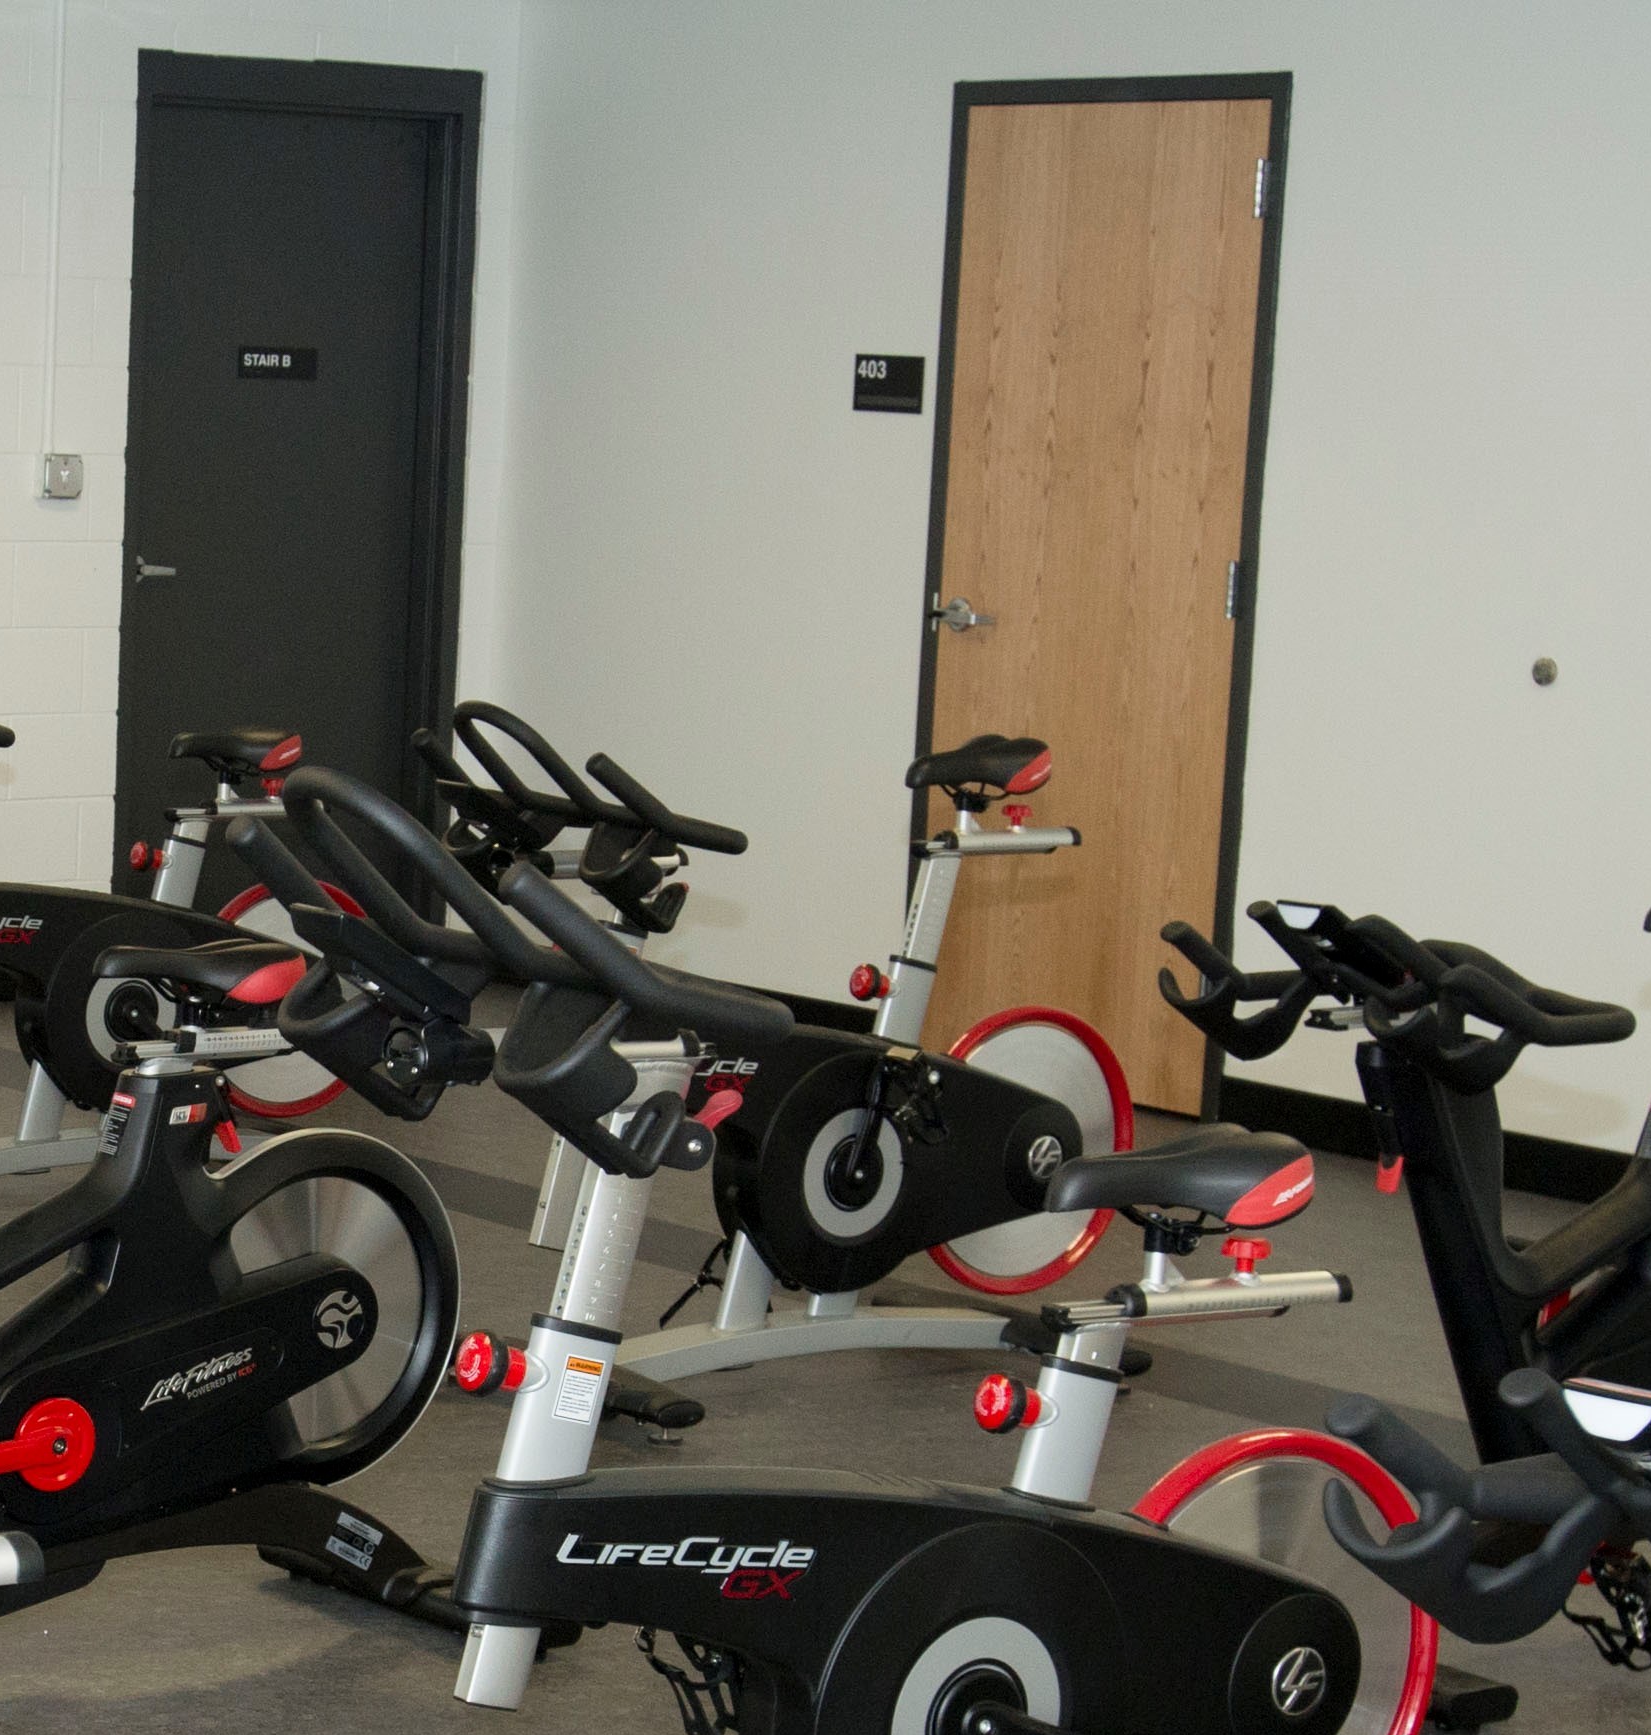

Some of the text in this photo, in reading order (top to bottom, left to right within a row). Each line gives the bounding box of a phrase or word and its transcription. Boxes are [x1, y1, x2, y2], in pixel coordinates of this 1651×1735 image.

[243, 353, 291, 368] STAIR B
[857, 359, 887, 379] 403
[187, 1377, 227, 1400] POWERED
[227, 1371, 238, 1385] BY
[556, 1533, 815, 1574] LifeCycle
[720, 1569, 801, 1601] GX
